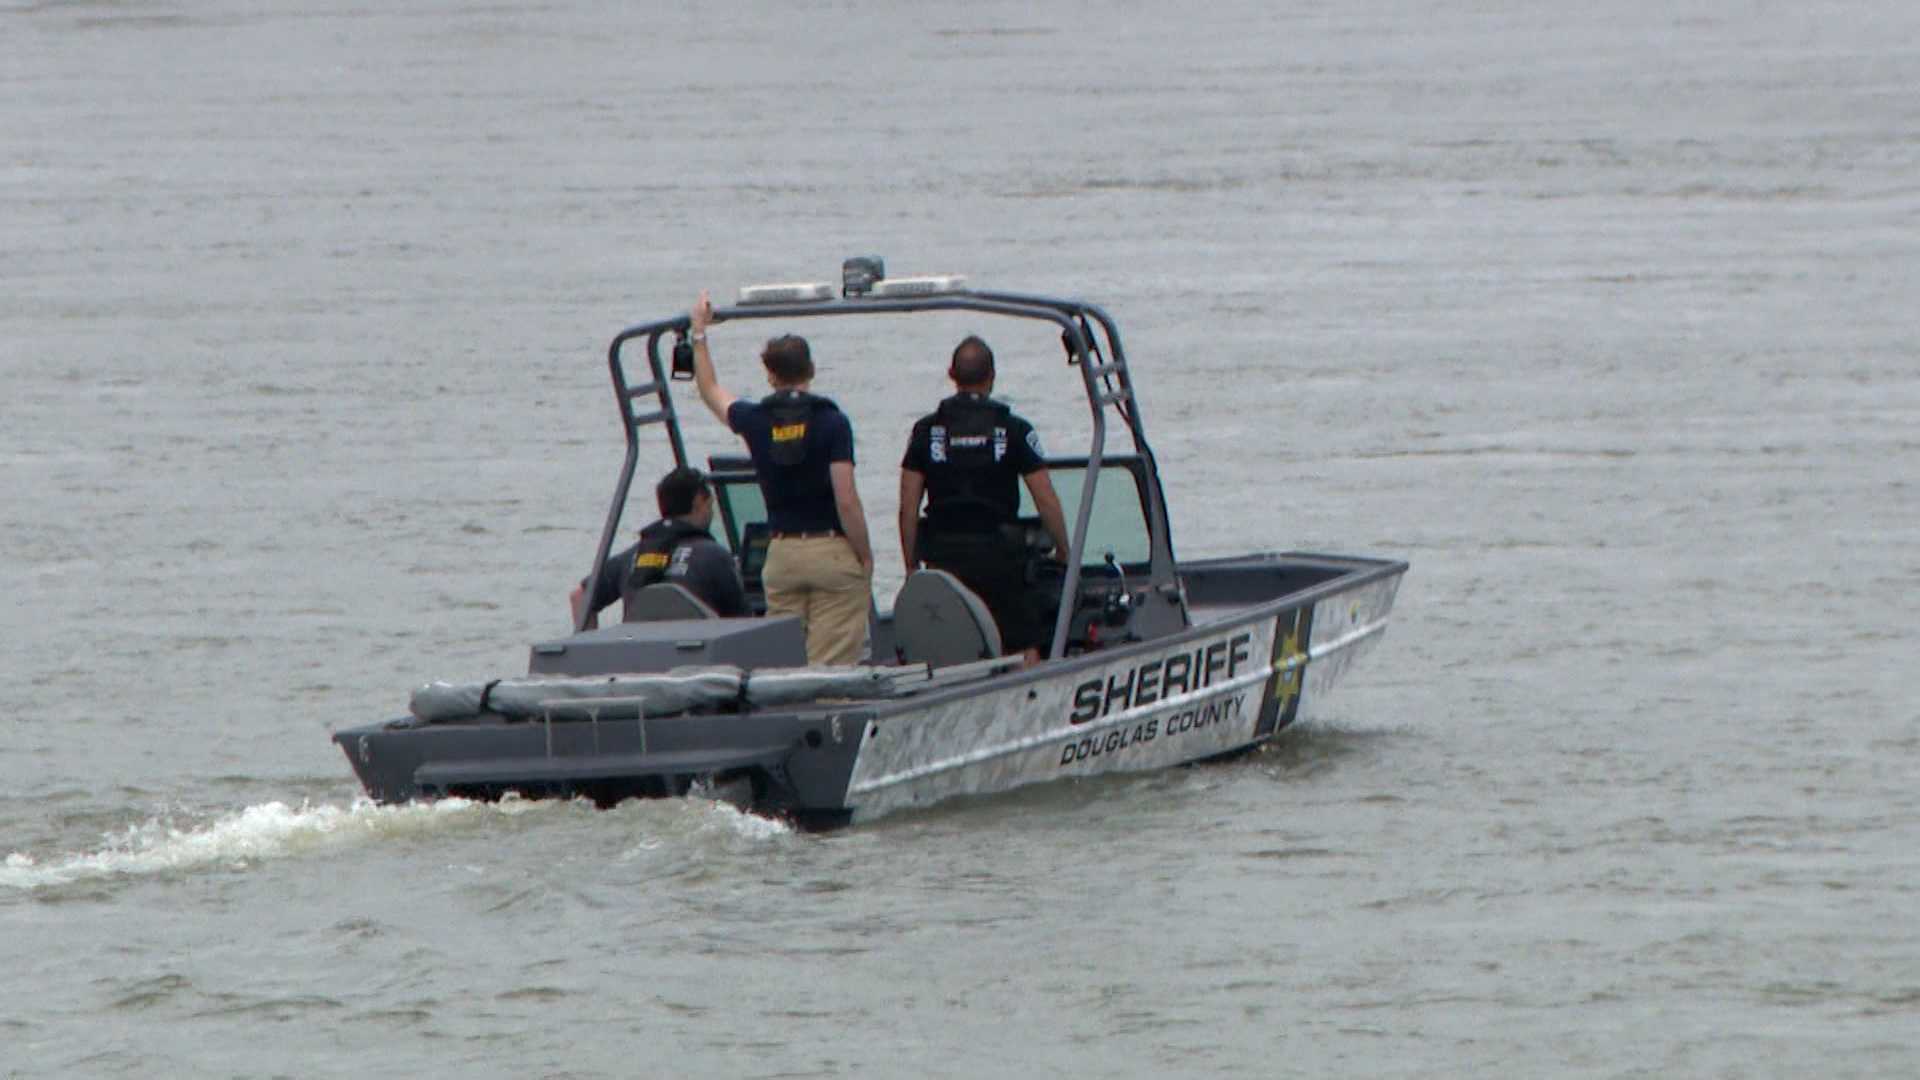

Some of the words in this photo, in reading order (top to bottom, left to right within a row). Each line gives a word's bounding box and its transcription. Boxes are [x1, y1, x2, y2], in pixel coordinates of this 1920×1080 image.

[1070, 632, 1250, 725] SHERIFF
[1060, 720, 1158, 766] DOUGLAS
[1166, 694, 1246, 737] COUNTY
